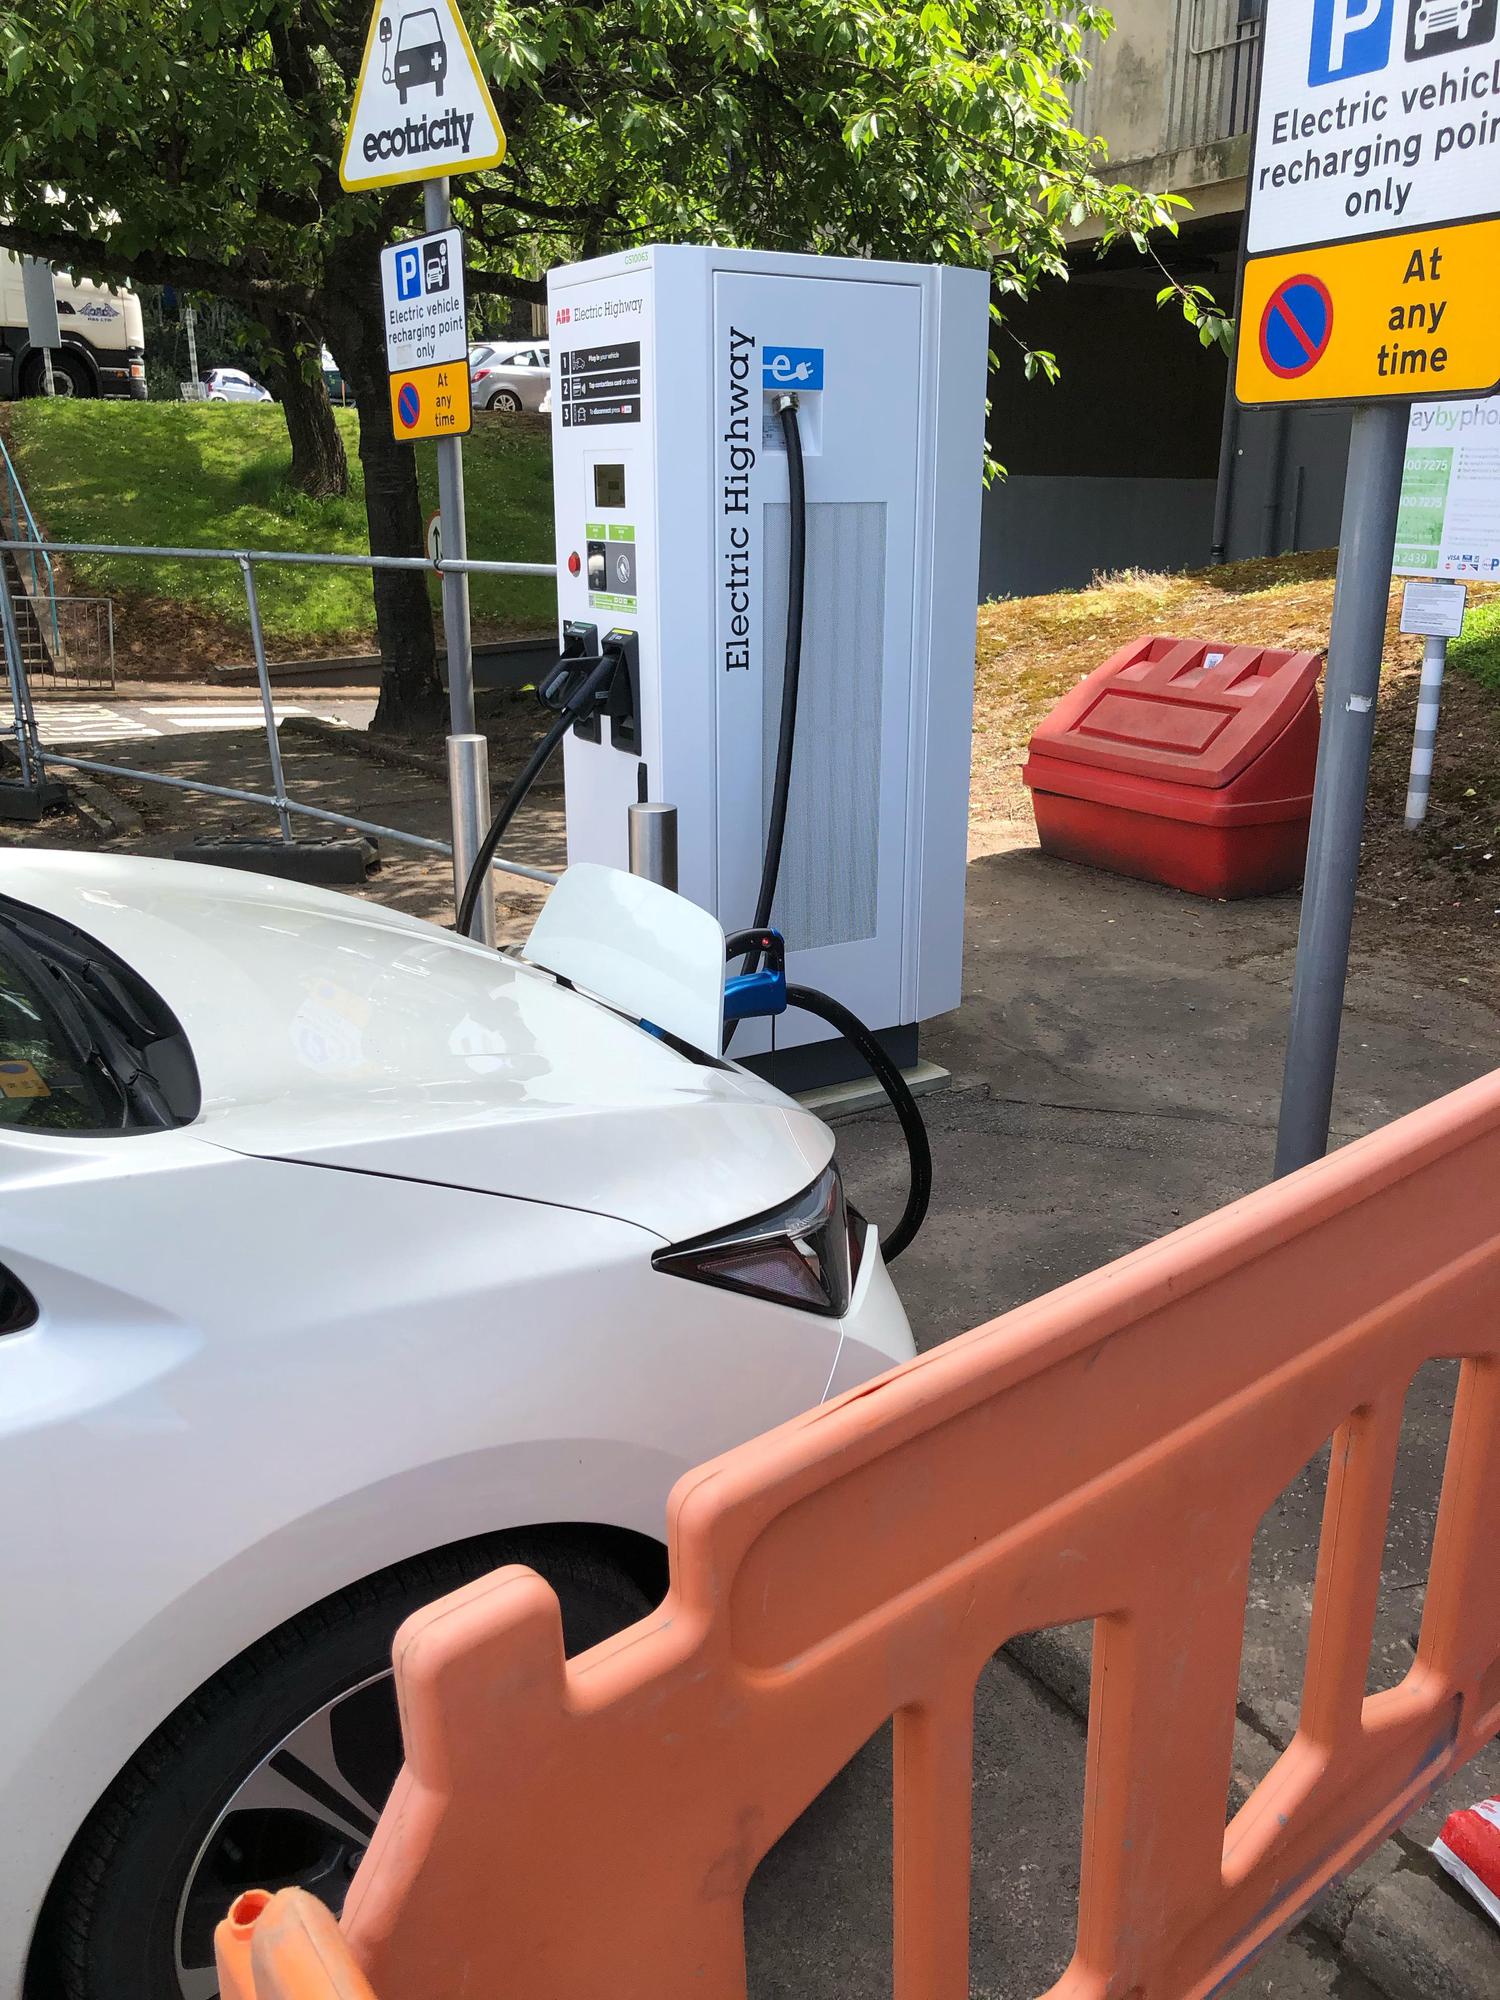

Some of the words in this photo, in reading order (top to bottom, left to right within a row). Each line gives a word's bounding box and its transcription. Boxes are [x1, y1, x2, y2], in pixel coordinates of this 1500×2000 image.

[1271, 90, 1388, 145] Electric
[1402, 60, 1500, 114] vehicl
[363, 107, 474, 163] ecotricity
[1259, 133, 1422, 191] recharging
[1345, 177, 1412, 217] only
[1402, 247, 1442, 284] At
[389, 305, 424, 325] Electric
[426, 296, 460, 317] vehicle
[556, 308, 571, 326] ABB
[574, 304, 603, 322] Electric
[604, 298, 643, 319] Highway
[1388, 301, 1447, 334] any
[388, 323, 436, 345] recharging
[439, 315, 464, 336] point
[416, 342, 435, 359] only
[562, 356, 567, 369] 1
[1377, 343, 1448, 377] time
[437, 372, 448, 387] At
[563, 382, 569, 395] 2
[435, 394, 452, 409] any
[564, 408, 569, 420] 3
[434, 413, 455, 428] time
[725, 326, 756, 515] Highway
[1411, 404, 1500, 432] aybypho
[1406, 459, 1421, 471] 00
[1402, 496, 1416, 508] 00
[725, 526, 750, 672] Electric
